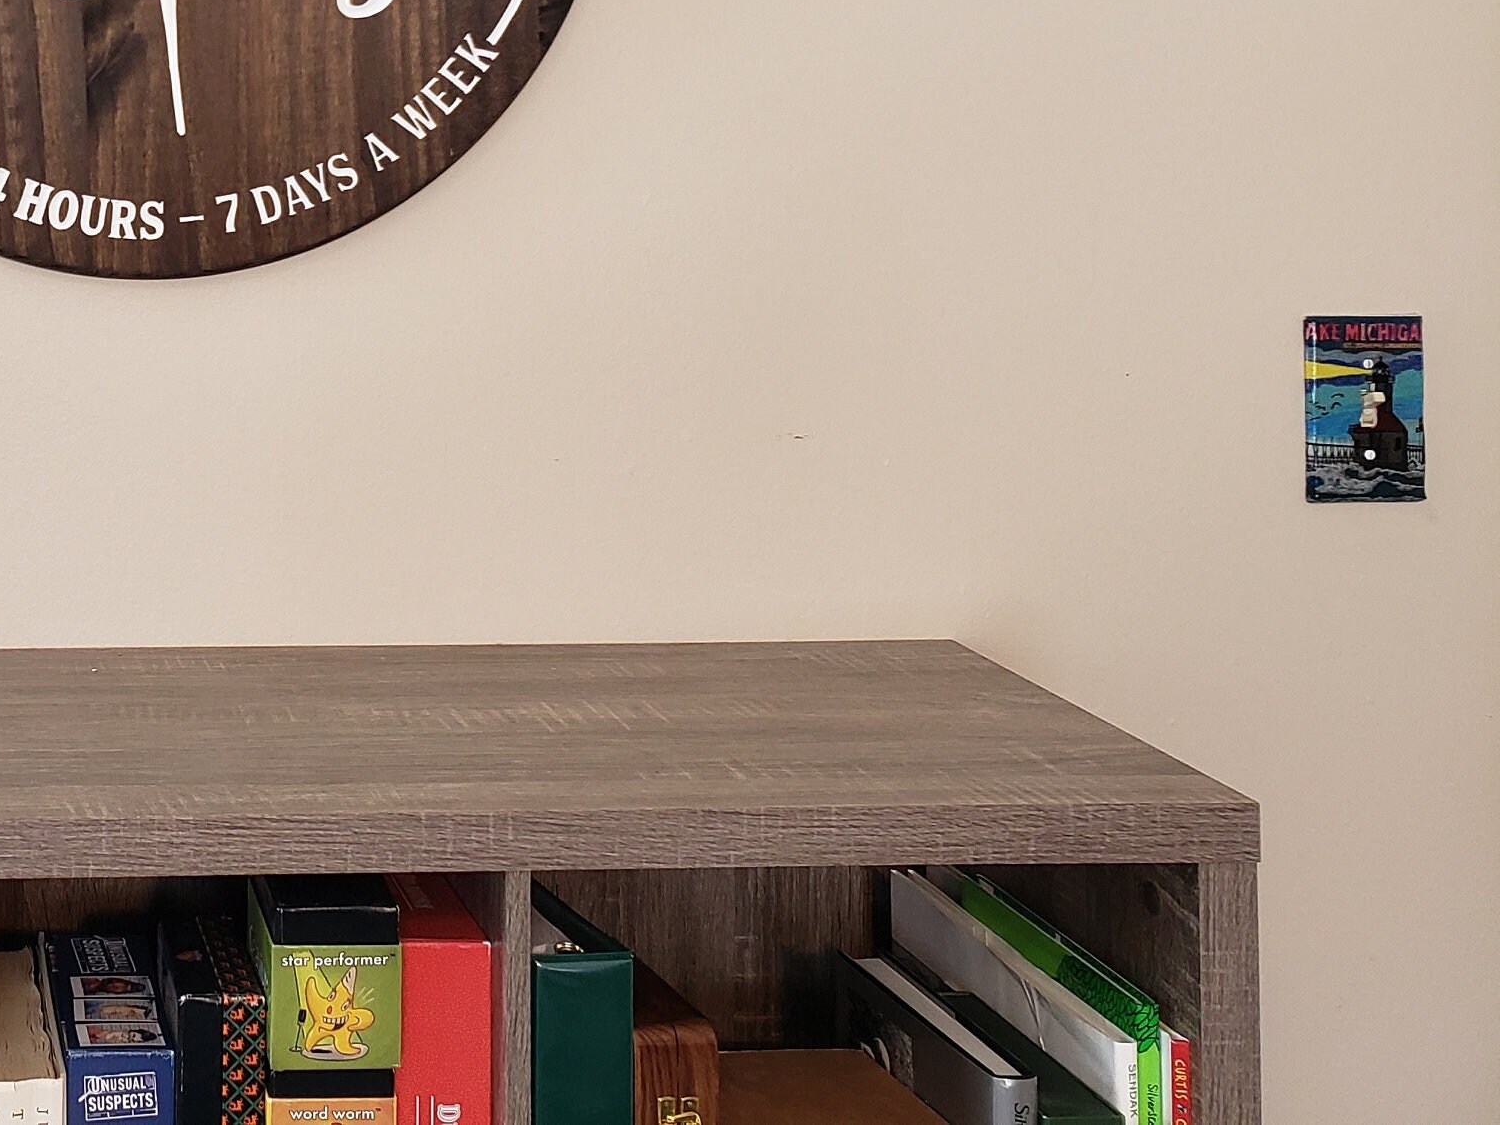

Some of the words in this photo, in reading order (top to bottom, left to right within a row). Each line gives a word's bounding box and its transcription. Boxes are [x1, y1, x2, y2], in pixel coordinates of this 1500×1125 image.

[13, 178, 165, 241] HOURS
[215, 193, 239, 233] 7
[251, 153, 359, 225] DAYS
[363, 132, 400, 171] A
[390, 32, 500, 140] WEEK
[1306, 322, 1340, 341] AKE
[1345, 323, 1420, 342] MICHIGA
[282, 956, 309, 966] star
[314, 952, 388, 970] performer
[90, 1076, 147, 1092] UNUSUAL
[1174, 1059, 1188, 1100] CURTIS
[1128, 1063, 1138, 1118] SENDAK
[88, 1092, 154, 1111] SUSPECTS
[289, 1106, 327, 1120] word
[332, 1109, 375, 1120] worm
